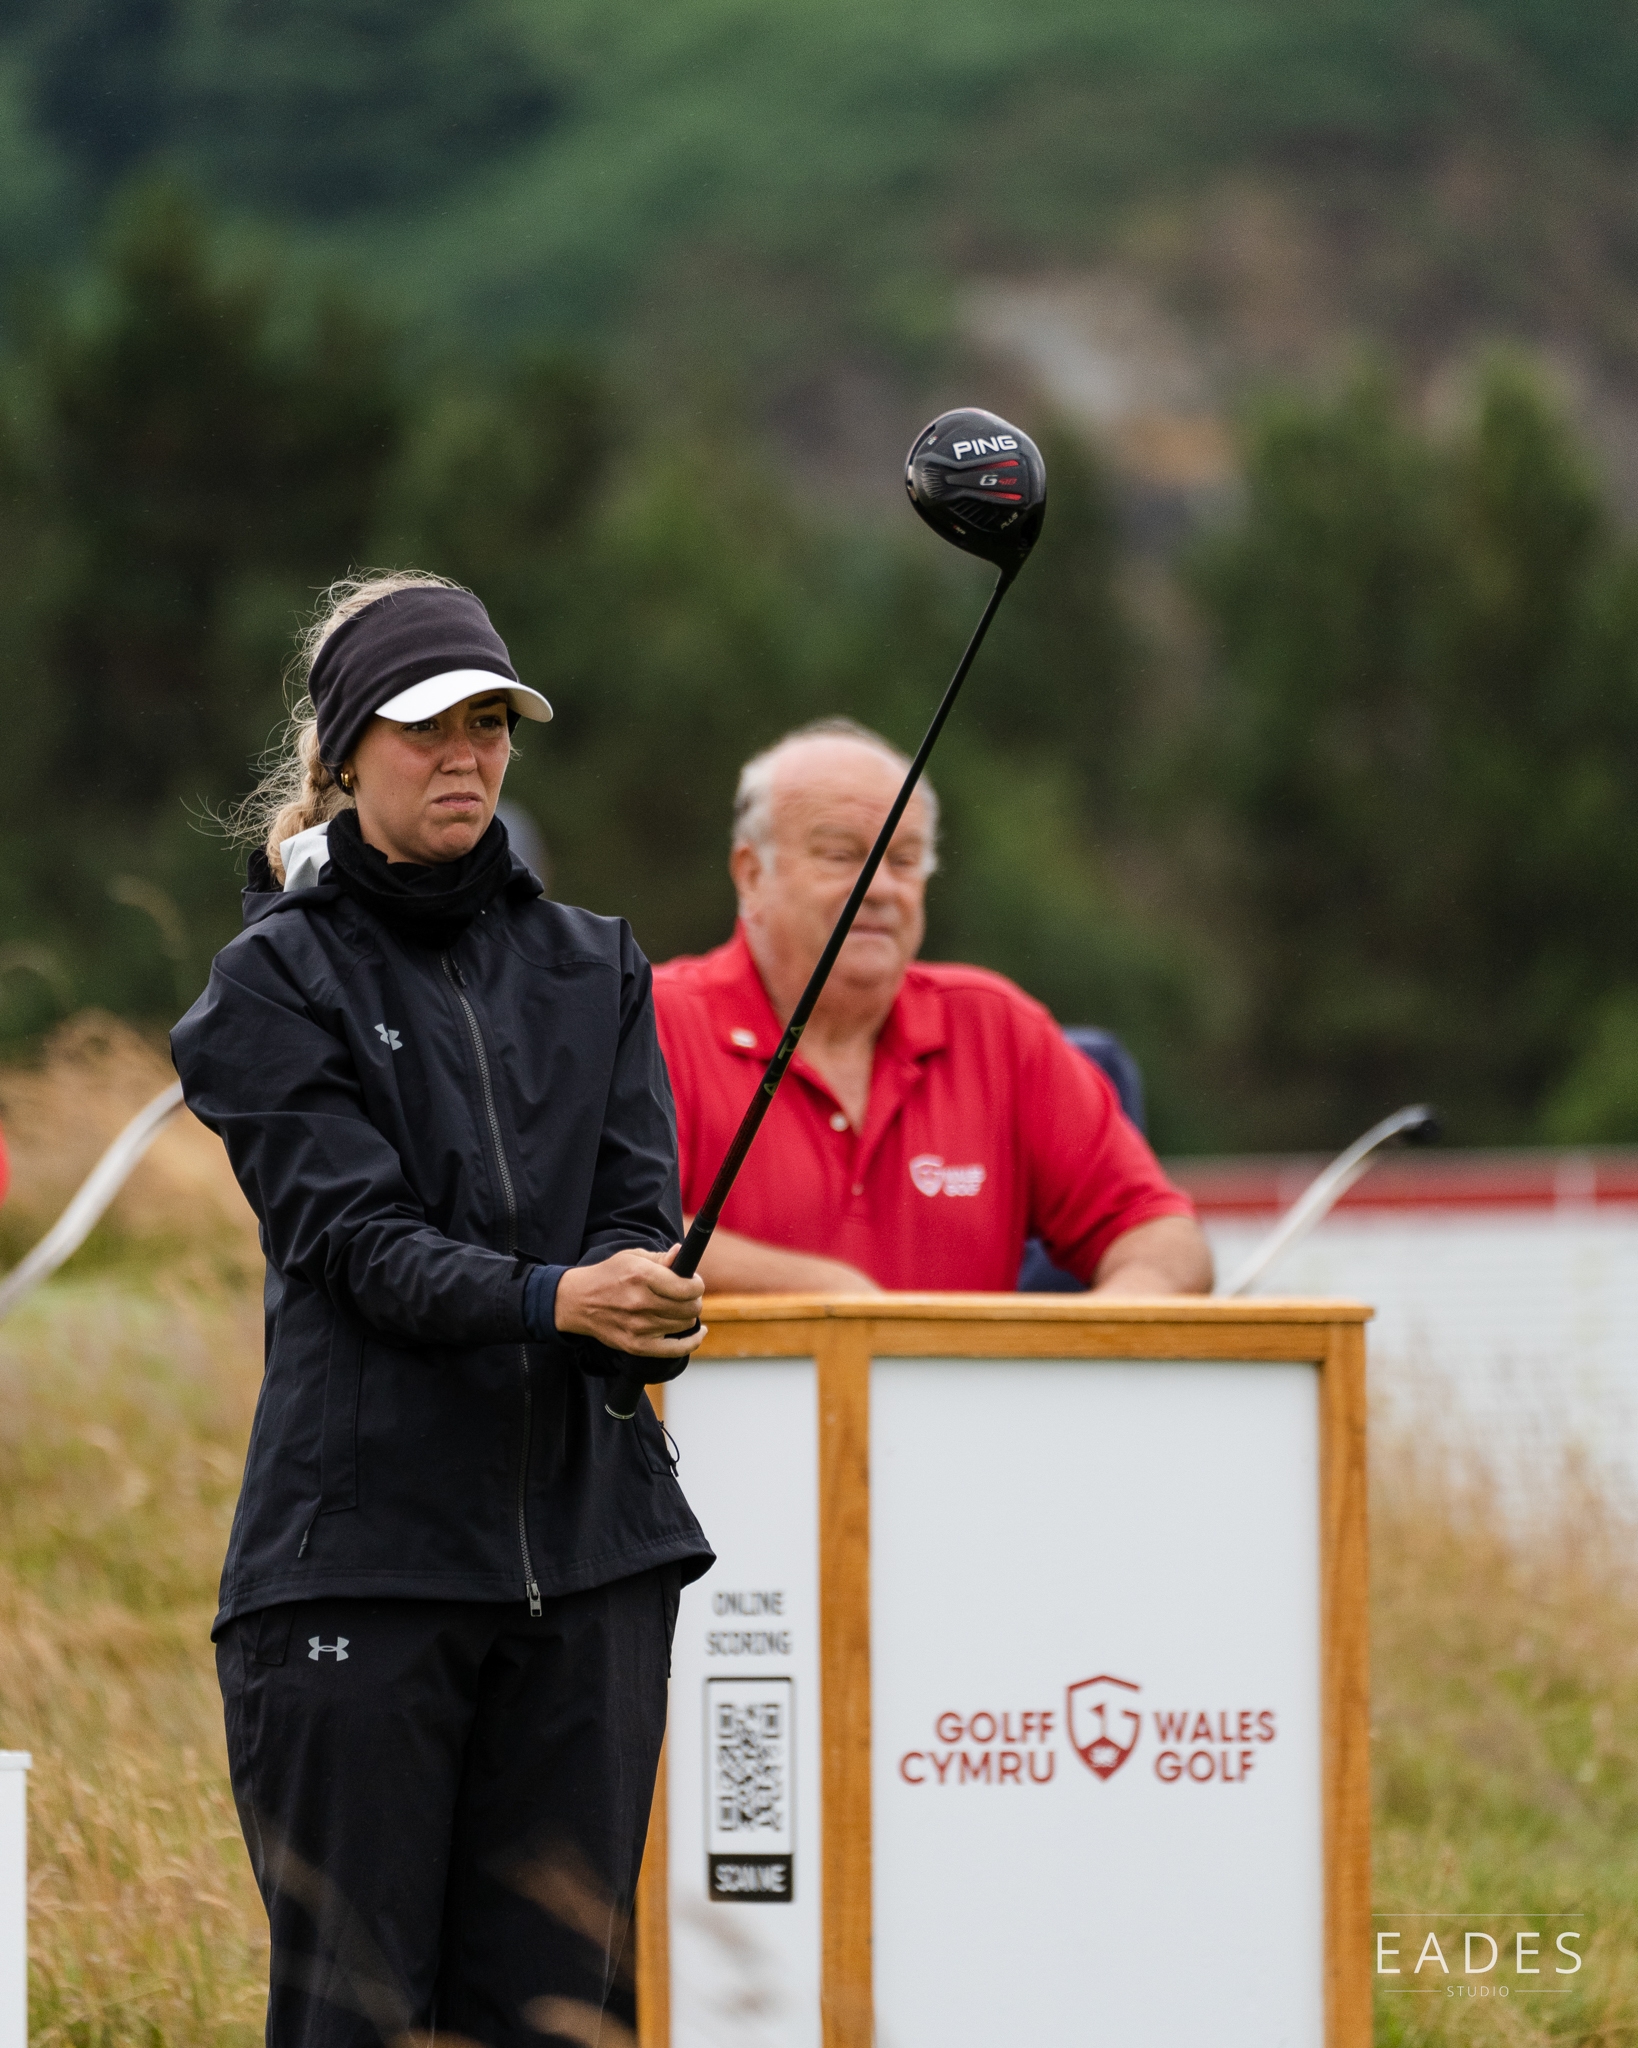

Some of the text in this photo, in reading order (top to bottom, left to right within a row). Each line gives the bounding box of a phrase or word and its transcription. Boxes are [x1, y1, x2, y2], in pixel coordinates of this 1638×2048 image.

[953, 435, 1018, 460] PING
[713, 1592, 784, 1615] ONLINE
[706, 1631, 791, 1655] SCORING
[936, 1711, 1054, 1744] GOLFF
[1154, 1710, 1275, 1744] WALES
[900, 1751, 1054, 1784] CYMRU
[1154, 1750, 1254, 1783] GOLF
